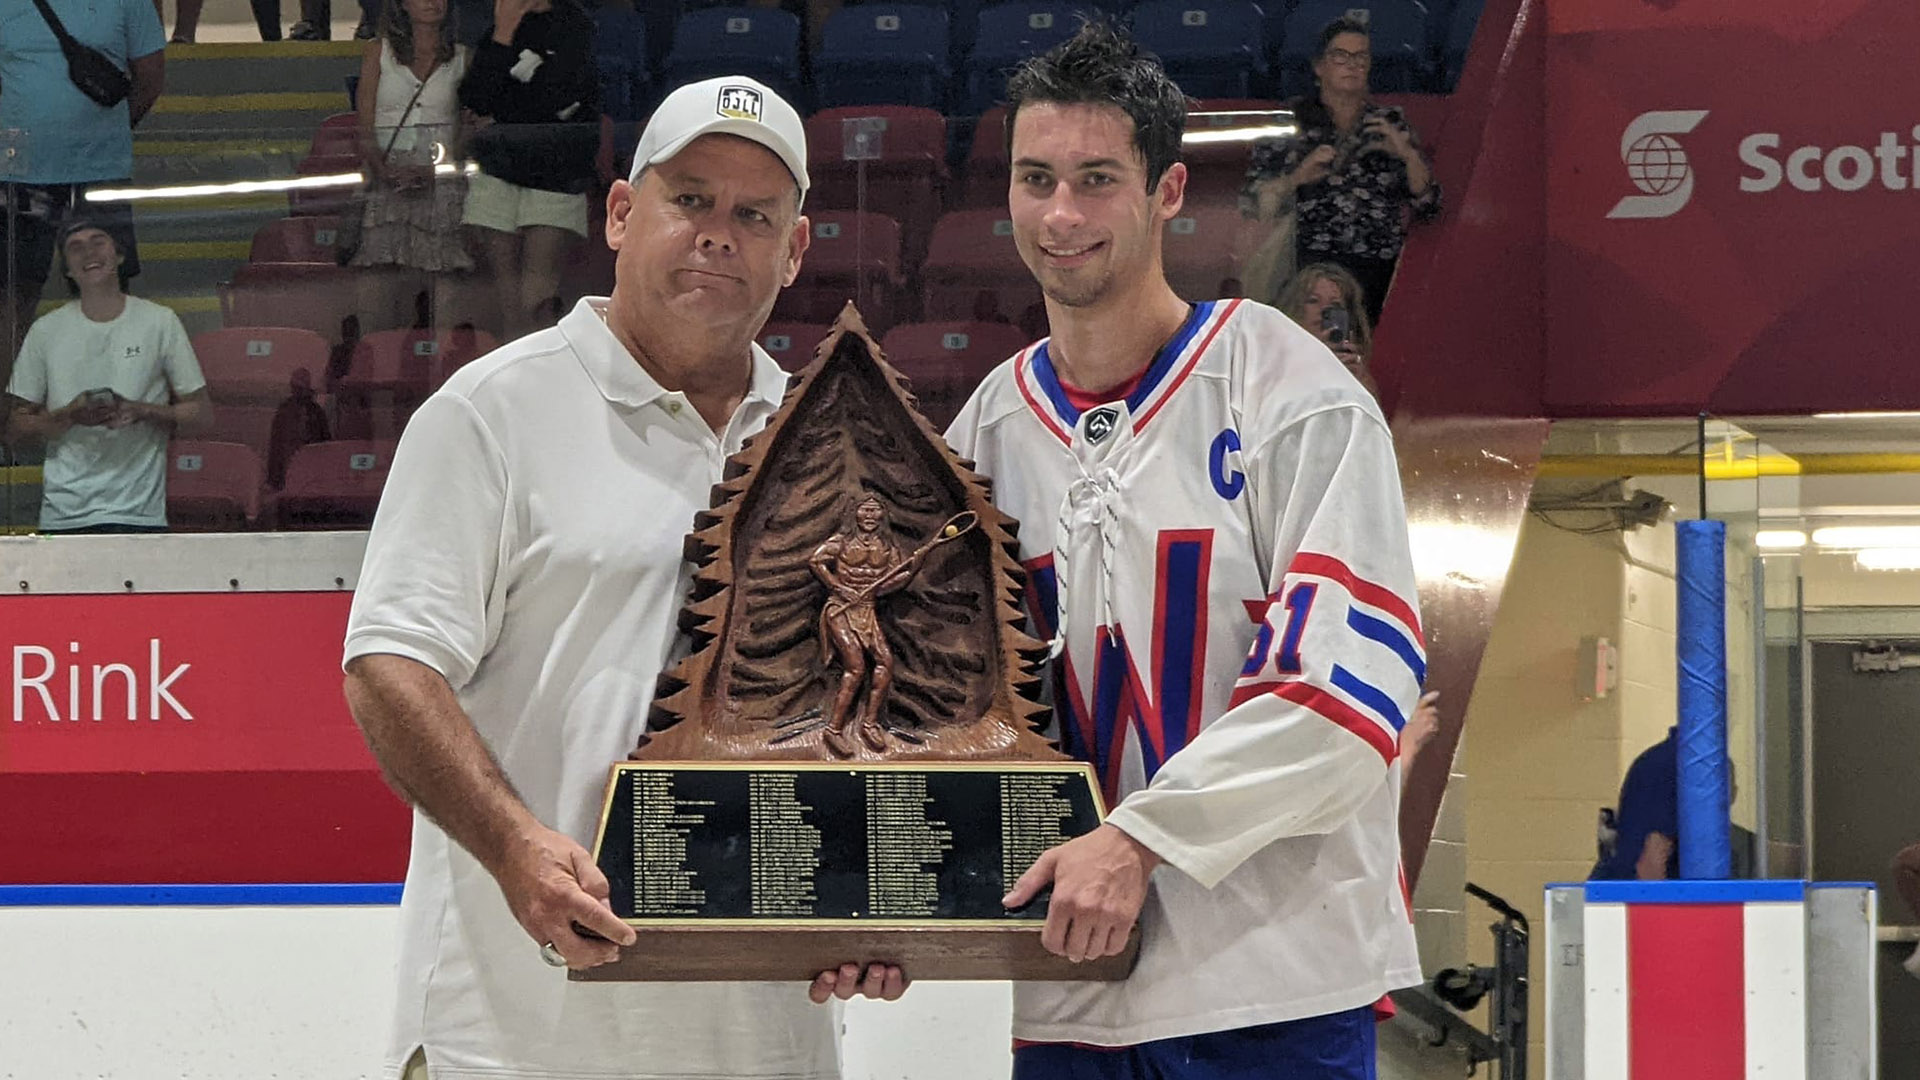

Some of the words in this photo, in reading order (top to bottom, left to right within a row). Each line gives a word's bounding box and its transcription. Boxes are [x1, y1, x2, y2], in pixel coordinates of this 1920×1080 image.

[722, 97, 757, 116] OJLL
[1209, 428, 1245, 501] C
[13, 638, 194, 721] Rink
